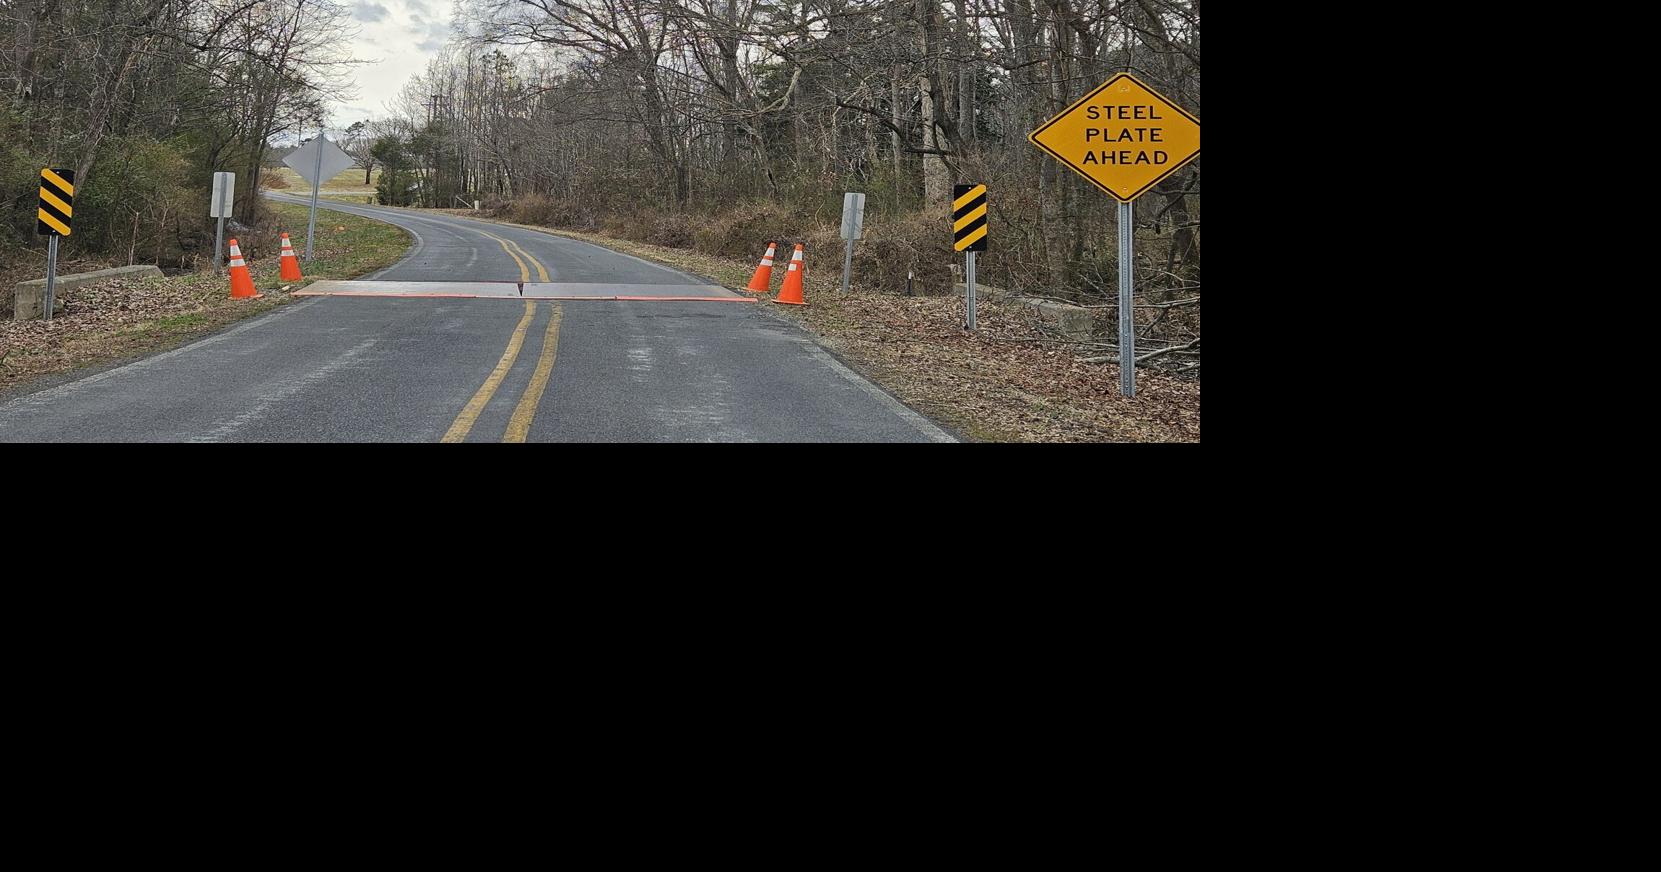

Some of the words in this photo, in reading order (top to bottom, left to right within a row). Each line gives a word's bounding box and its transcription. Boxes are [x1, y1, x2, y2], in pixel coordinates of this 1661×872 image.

[1086, 105, 1163, 120] STEEL
[1085, 128, 1163, 142] PLATE
[1082, 150, 1169, 165] AHEAD
